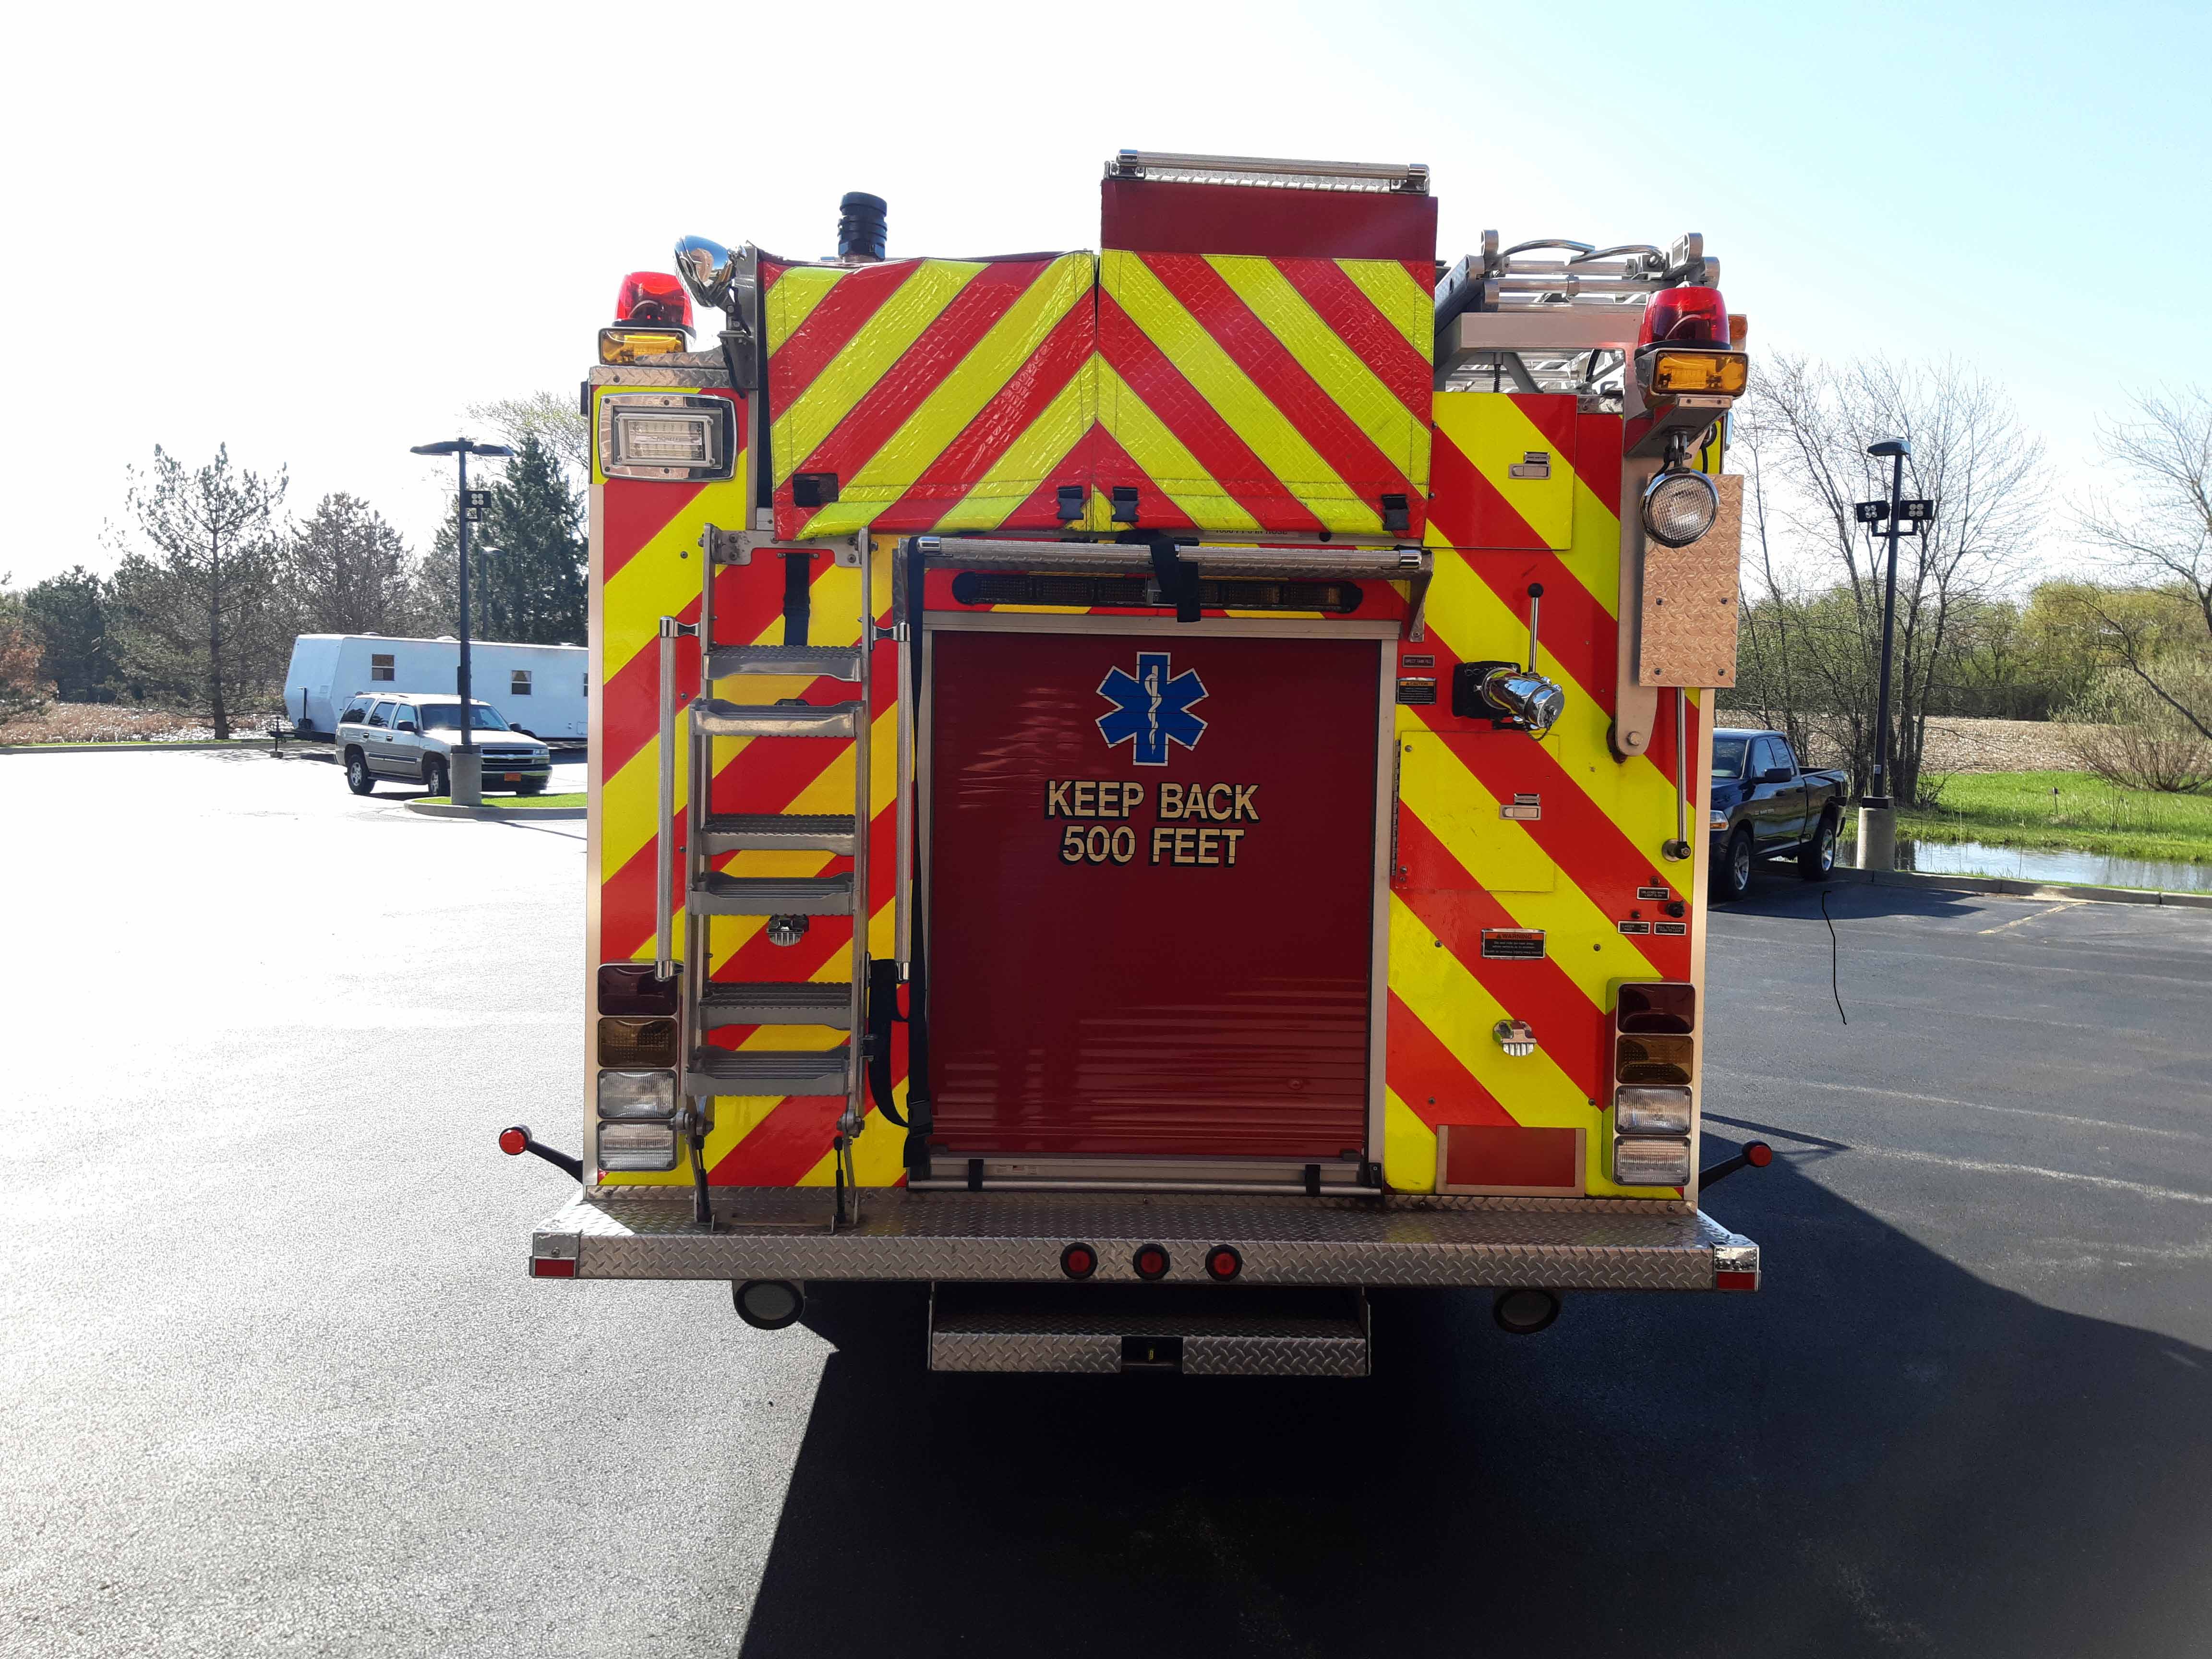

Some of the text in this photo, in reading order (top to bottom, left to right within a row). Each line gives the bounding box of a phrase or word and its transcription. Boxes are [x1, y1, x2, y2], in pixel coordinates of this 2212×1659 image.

[1045, 780, 1260, 823] KEEP BACK
[1060, 825, 1245, 867] 500 FEET
